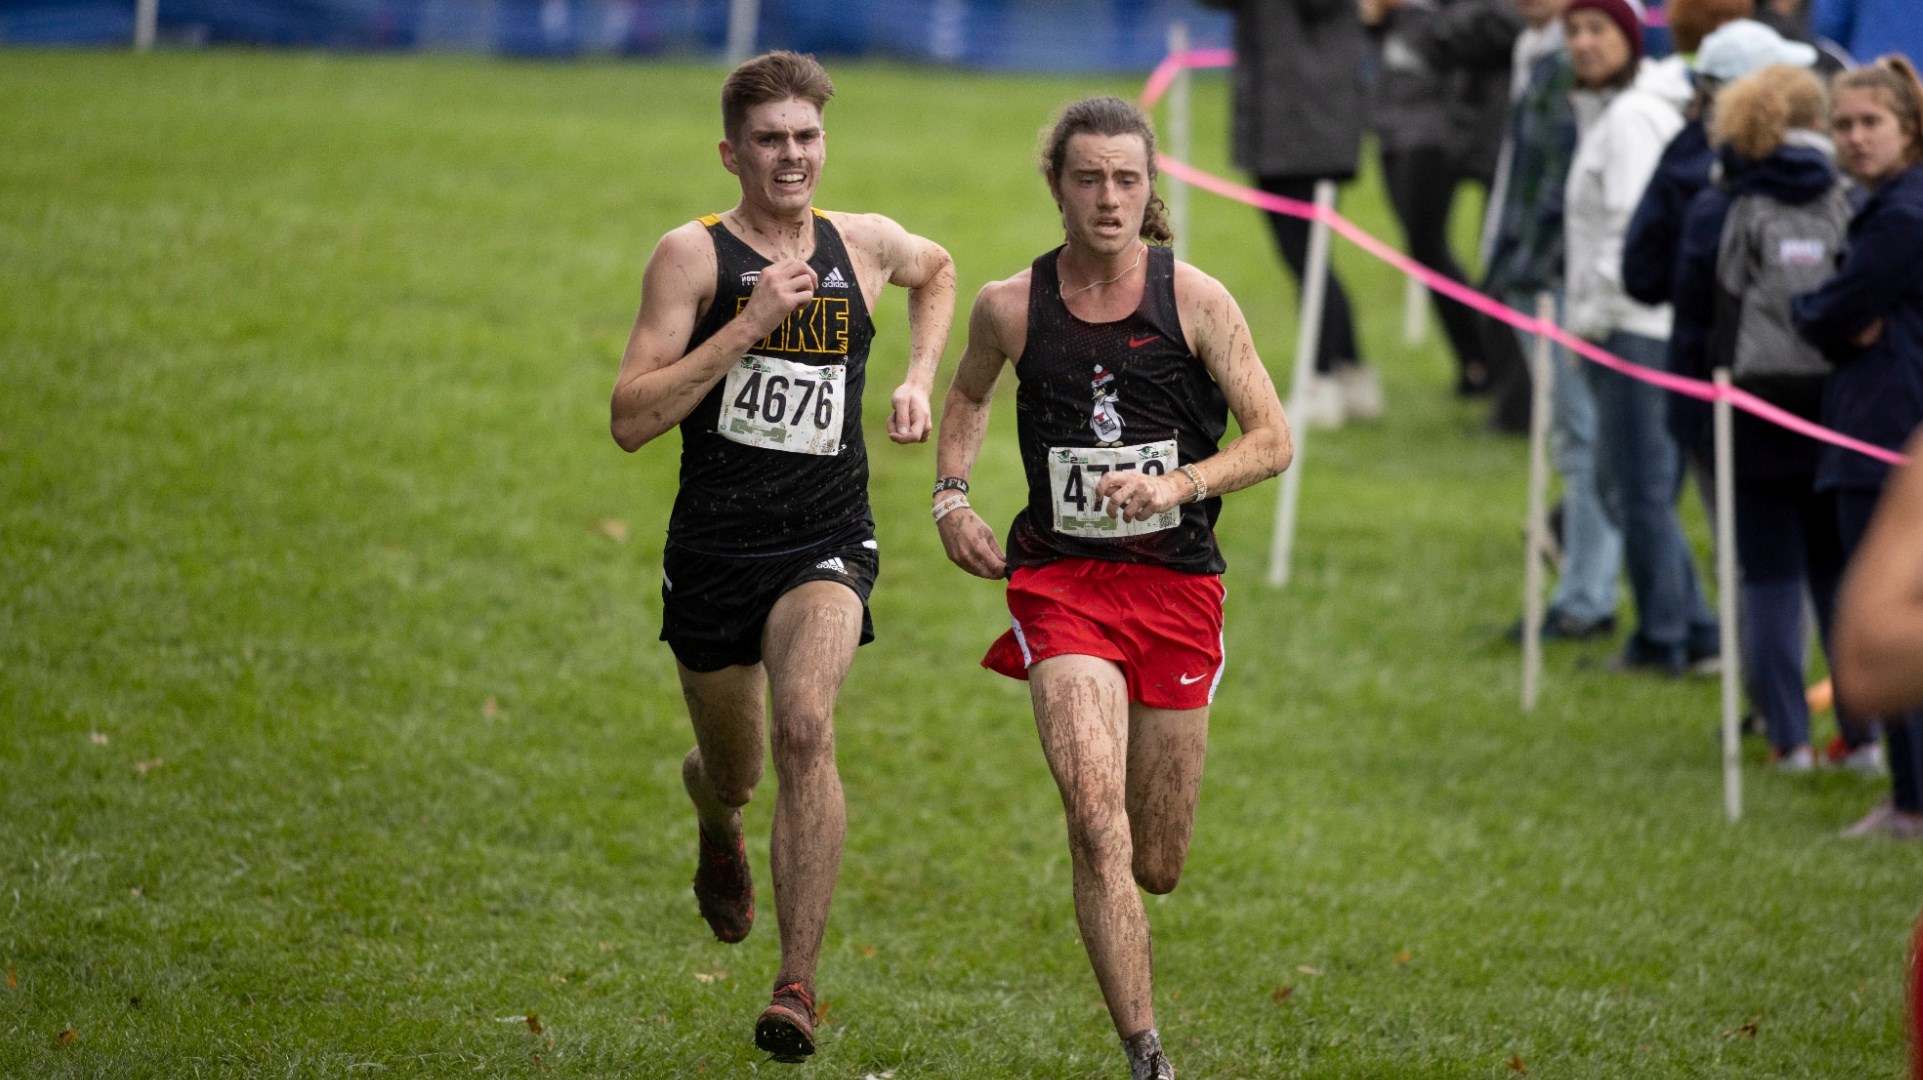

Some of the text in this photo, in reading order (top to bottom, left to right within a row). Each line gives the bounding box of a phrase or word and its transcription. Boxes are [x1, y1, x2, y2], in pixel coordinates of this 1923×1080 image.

[821, 280, 849, 289] adidas
[733, 372, 834, 430] 4676
[816, 563, 848, 575] adidas
